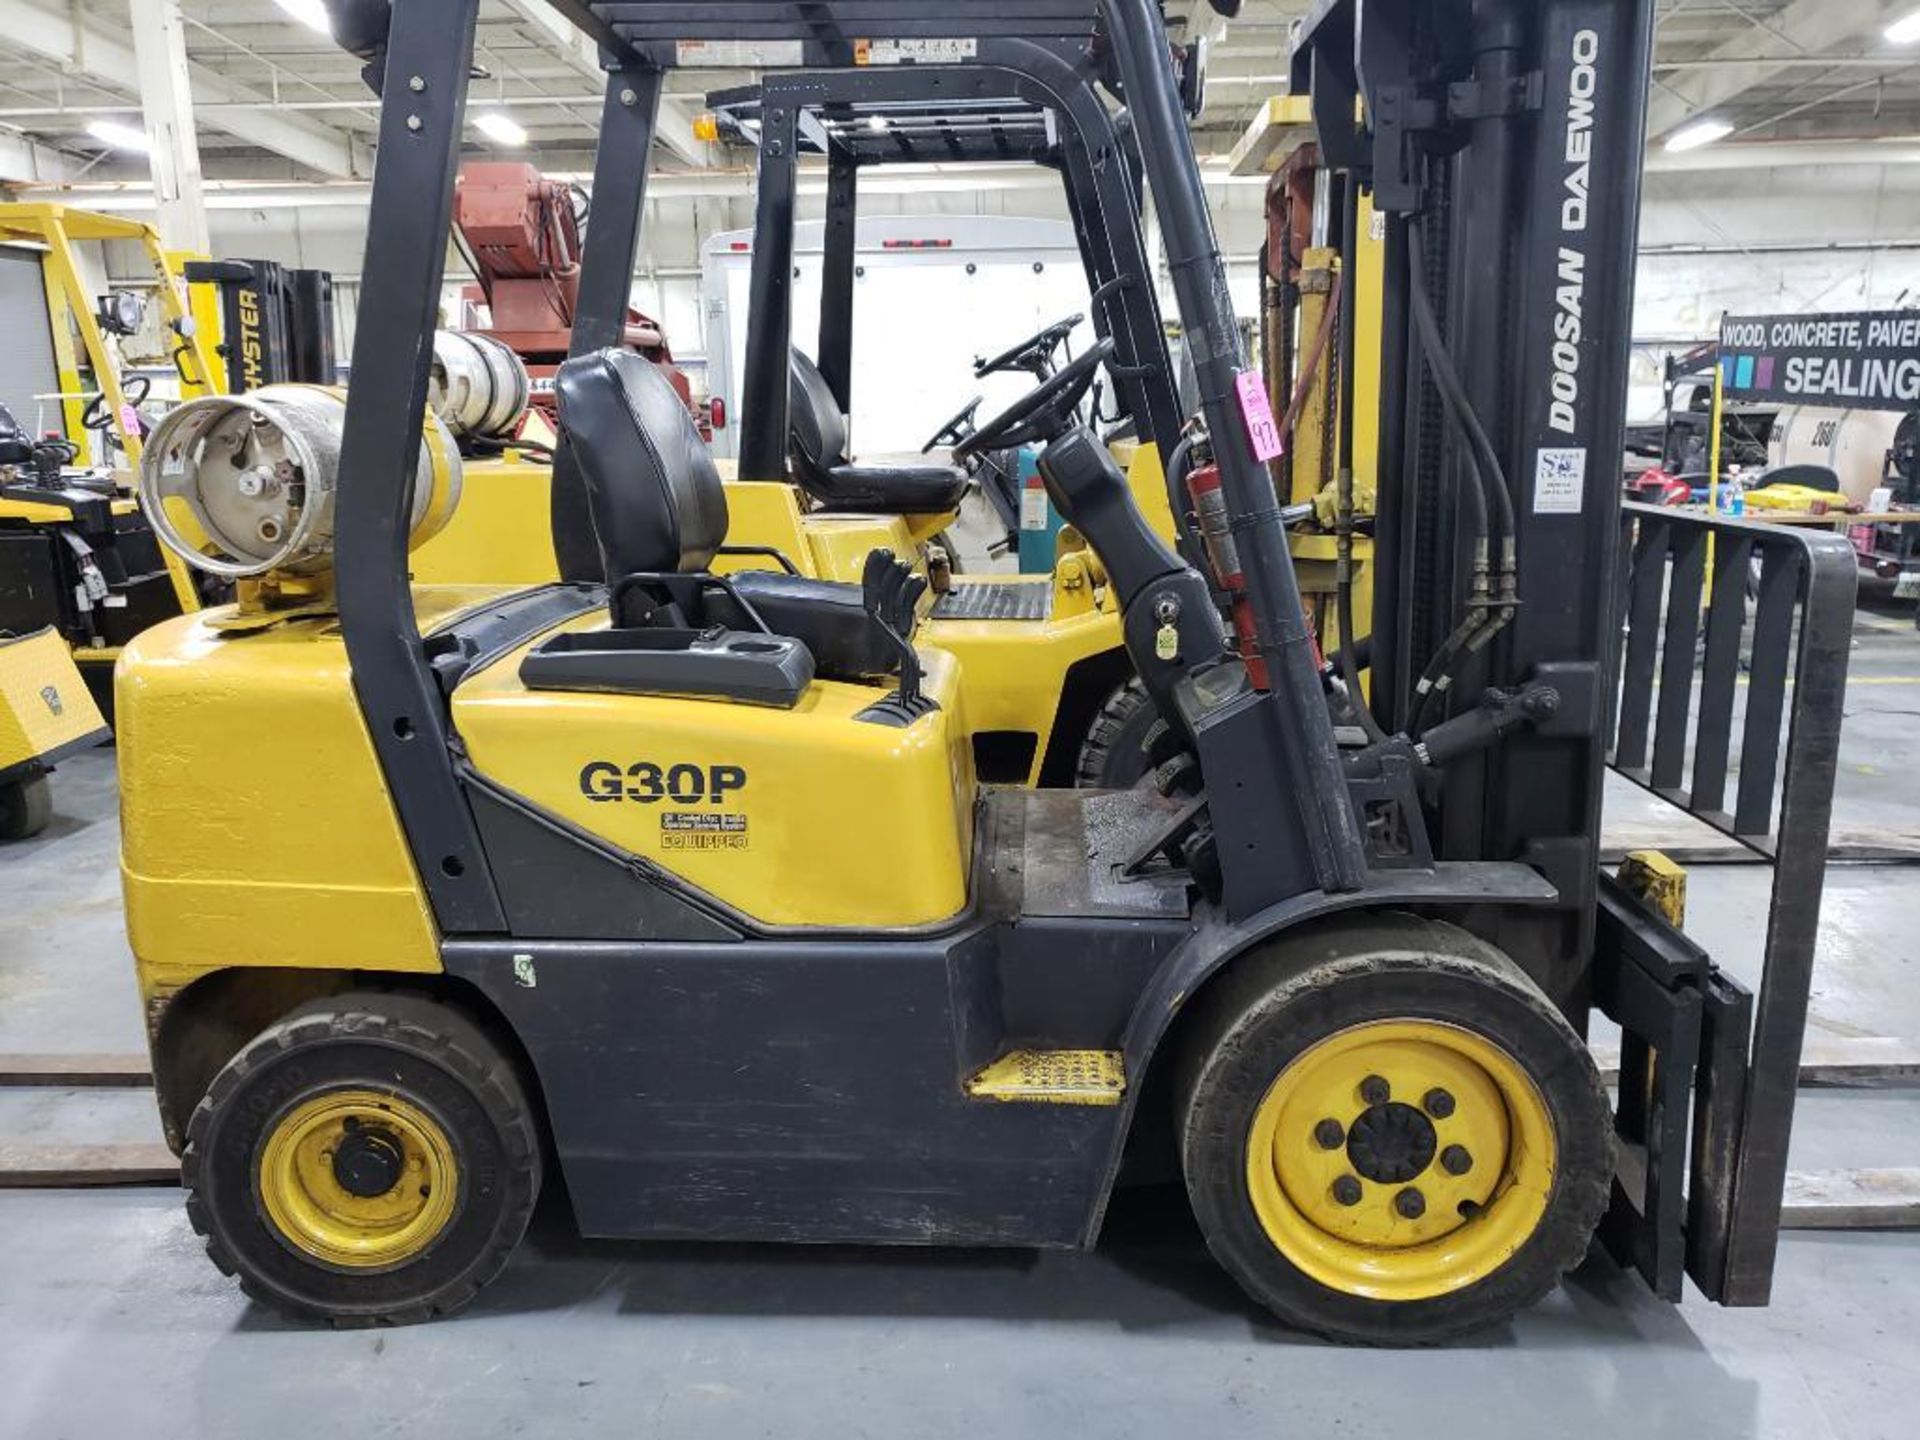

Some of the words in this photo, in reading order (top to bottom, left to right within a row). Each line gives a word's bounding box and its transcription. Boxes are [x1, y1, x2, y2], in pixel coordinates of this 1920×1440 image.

[1562, 29, 1598, 231] DAEWOO
[240, 289, 263, 392] HYSTER
[1549, 247, 1585, 434] DOOSAN
[1722, 324, 1767, 350] WOOD,
[1771, 319, 1863, 351] CONCRETE,
[1784, 356, 1920, 400] SEALING
[1252, 421, 1275, 452] 97
[579, 761, 747, 804] G30P
[661, 832, 748, 849] EQUIPPED
